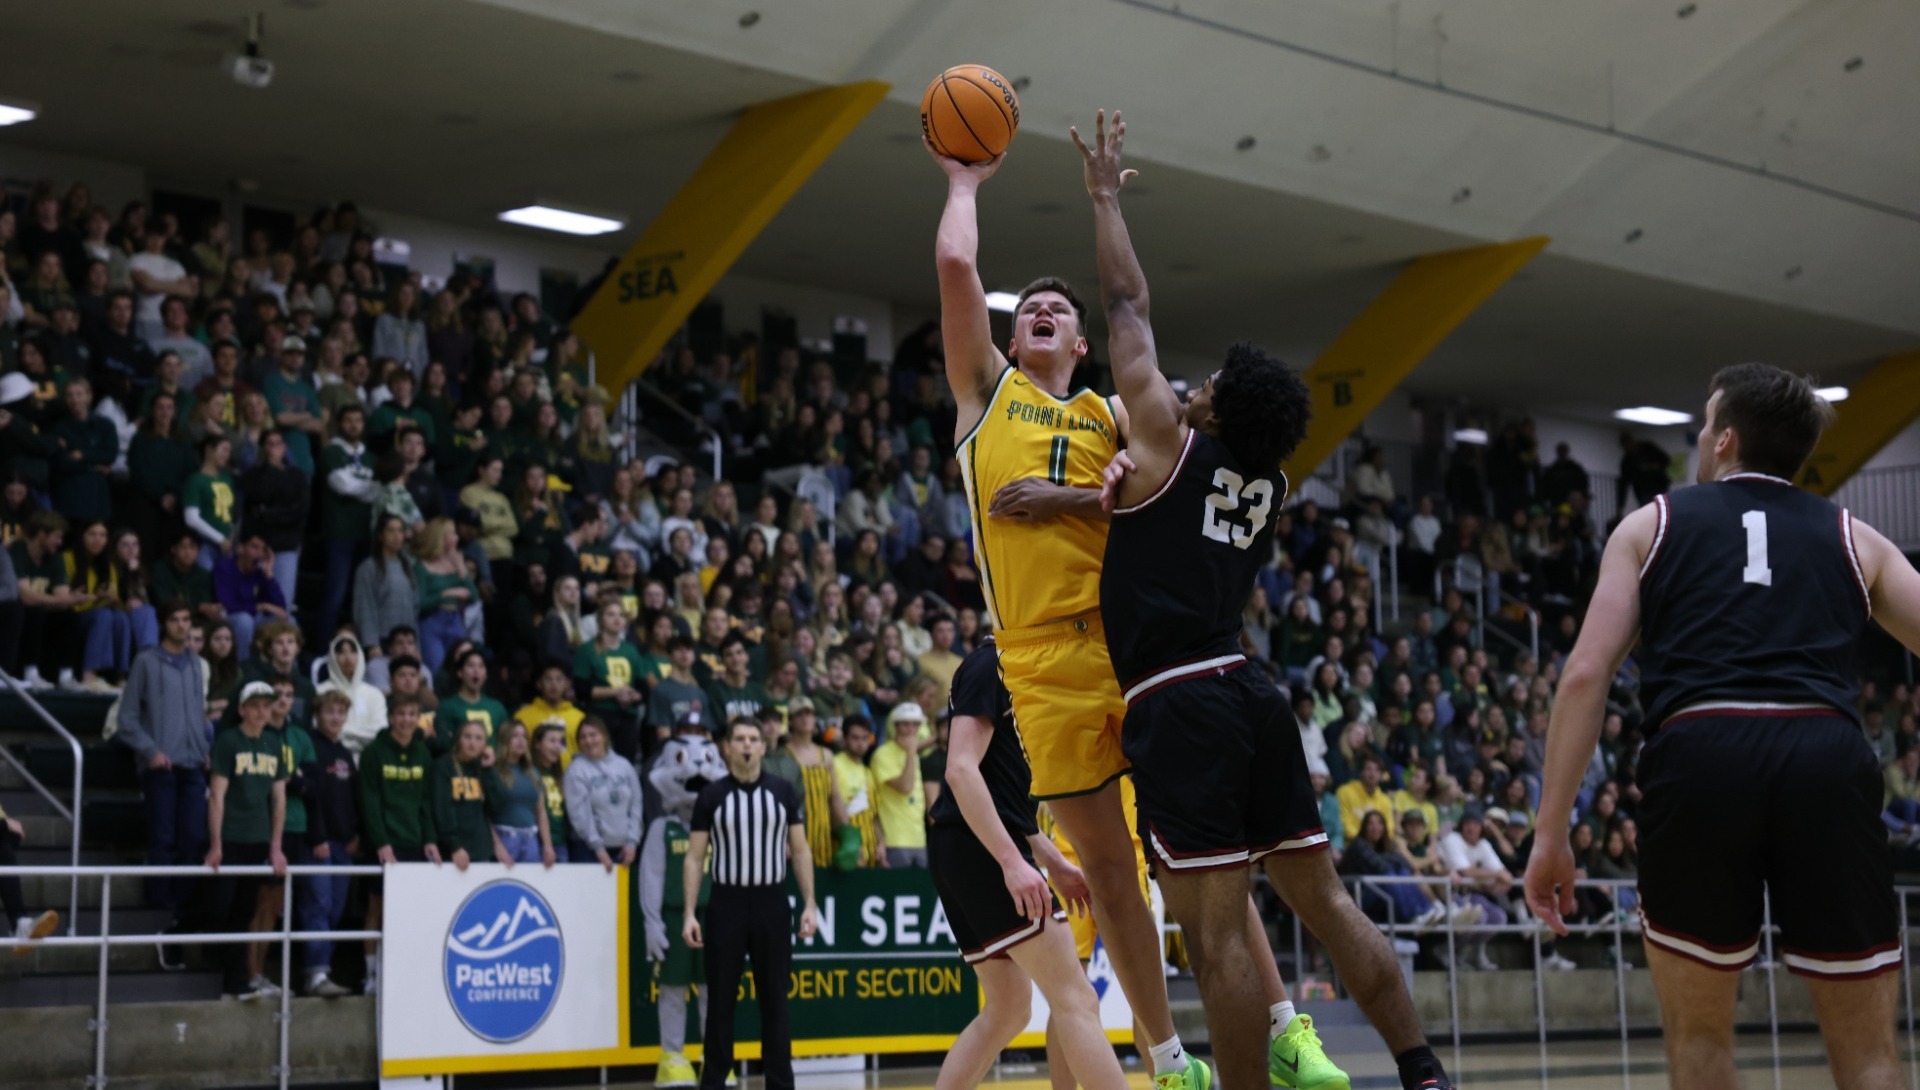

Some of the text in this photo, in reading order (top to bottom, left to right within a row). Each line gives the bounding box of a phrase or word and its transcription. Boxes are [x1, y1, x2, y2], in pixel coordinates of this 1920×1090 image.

[618, 266, 677, 303] SEA
[1007, 400, 1065, 428] POINT
[1202, 466, 1274, 550] 23
[1741, 509, 1772, 587] 1
[860, 894, 957, 947] SEA
[455, 961, 553, 988] PacWest
[855, 966, 962, 999] SECTION
[467, 988, 541, 1003] CONFERENCE
